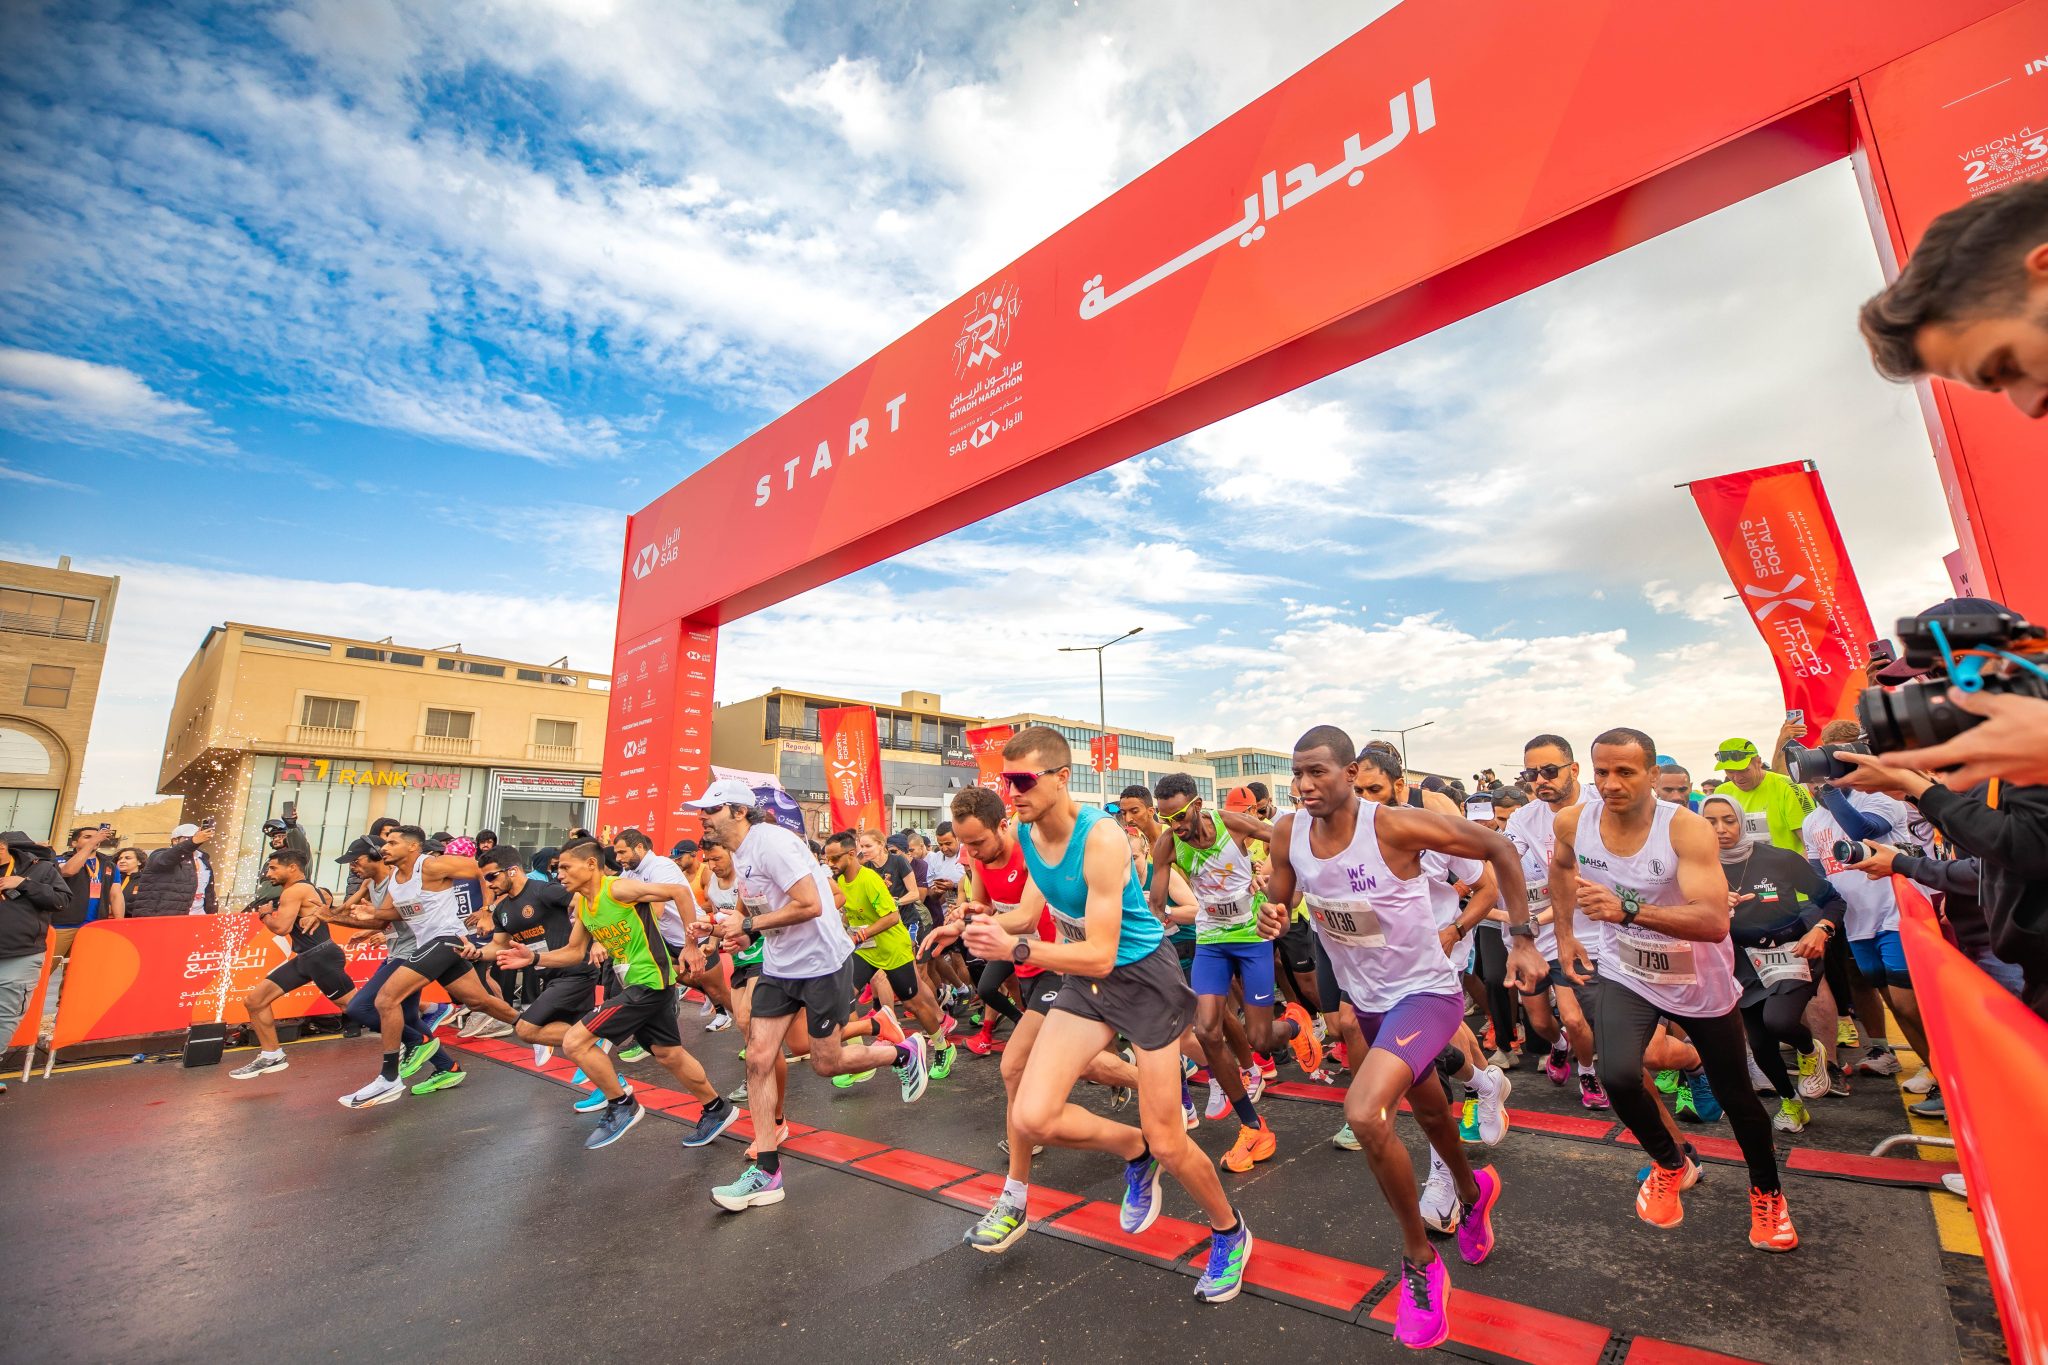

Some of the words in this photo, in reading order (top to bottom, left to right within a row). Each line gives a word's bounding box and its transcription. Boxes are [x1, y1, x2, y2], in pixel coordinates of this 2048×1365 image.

[1958, 134, 2016, 162] VISION
[1079, 77, 1436, 320] البداية
[984, 361, 1023, 391] ماراثون
[949, 398, 978, 421] RIYADH
[978, 373, 1023, 405] MARATHON
[950, 381, 982, 410] الرياض
[754, 392, 907, 507] START
[949, 440, 968, 457] SAB
[1756, 516, 1777, 544] ALL
[660, 550, 679, 567] SAB
[1740, 520, 1769, 579] SPORTS
[1764, 545, 1785, 576] FOR
[337, 769, 409, 788] RANK
[411, 772, 461, 790] ONE
[1347, 864, 1366, 880] WE
[1350, 876, 1377, 893] RUN
[1217, 901, 1239, 916] 5774
[1324, 909, 1357, 933] 8136
[357, 951, 387, 962] ALL
[1635, 948, 1670, 971] 7730
[1761, 952, 1788, 964] 7771
